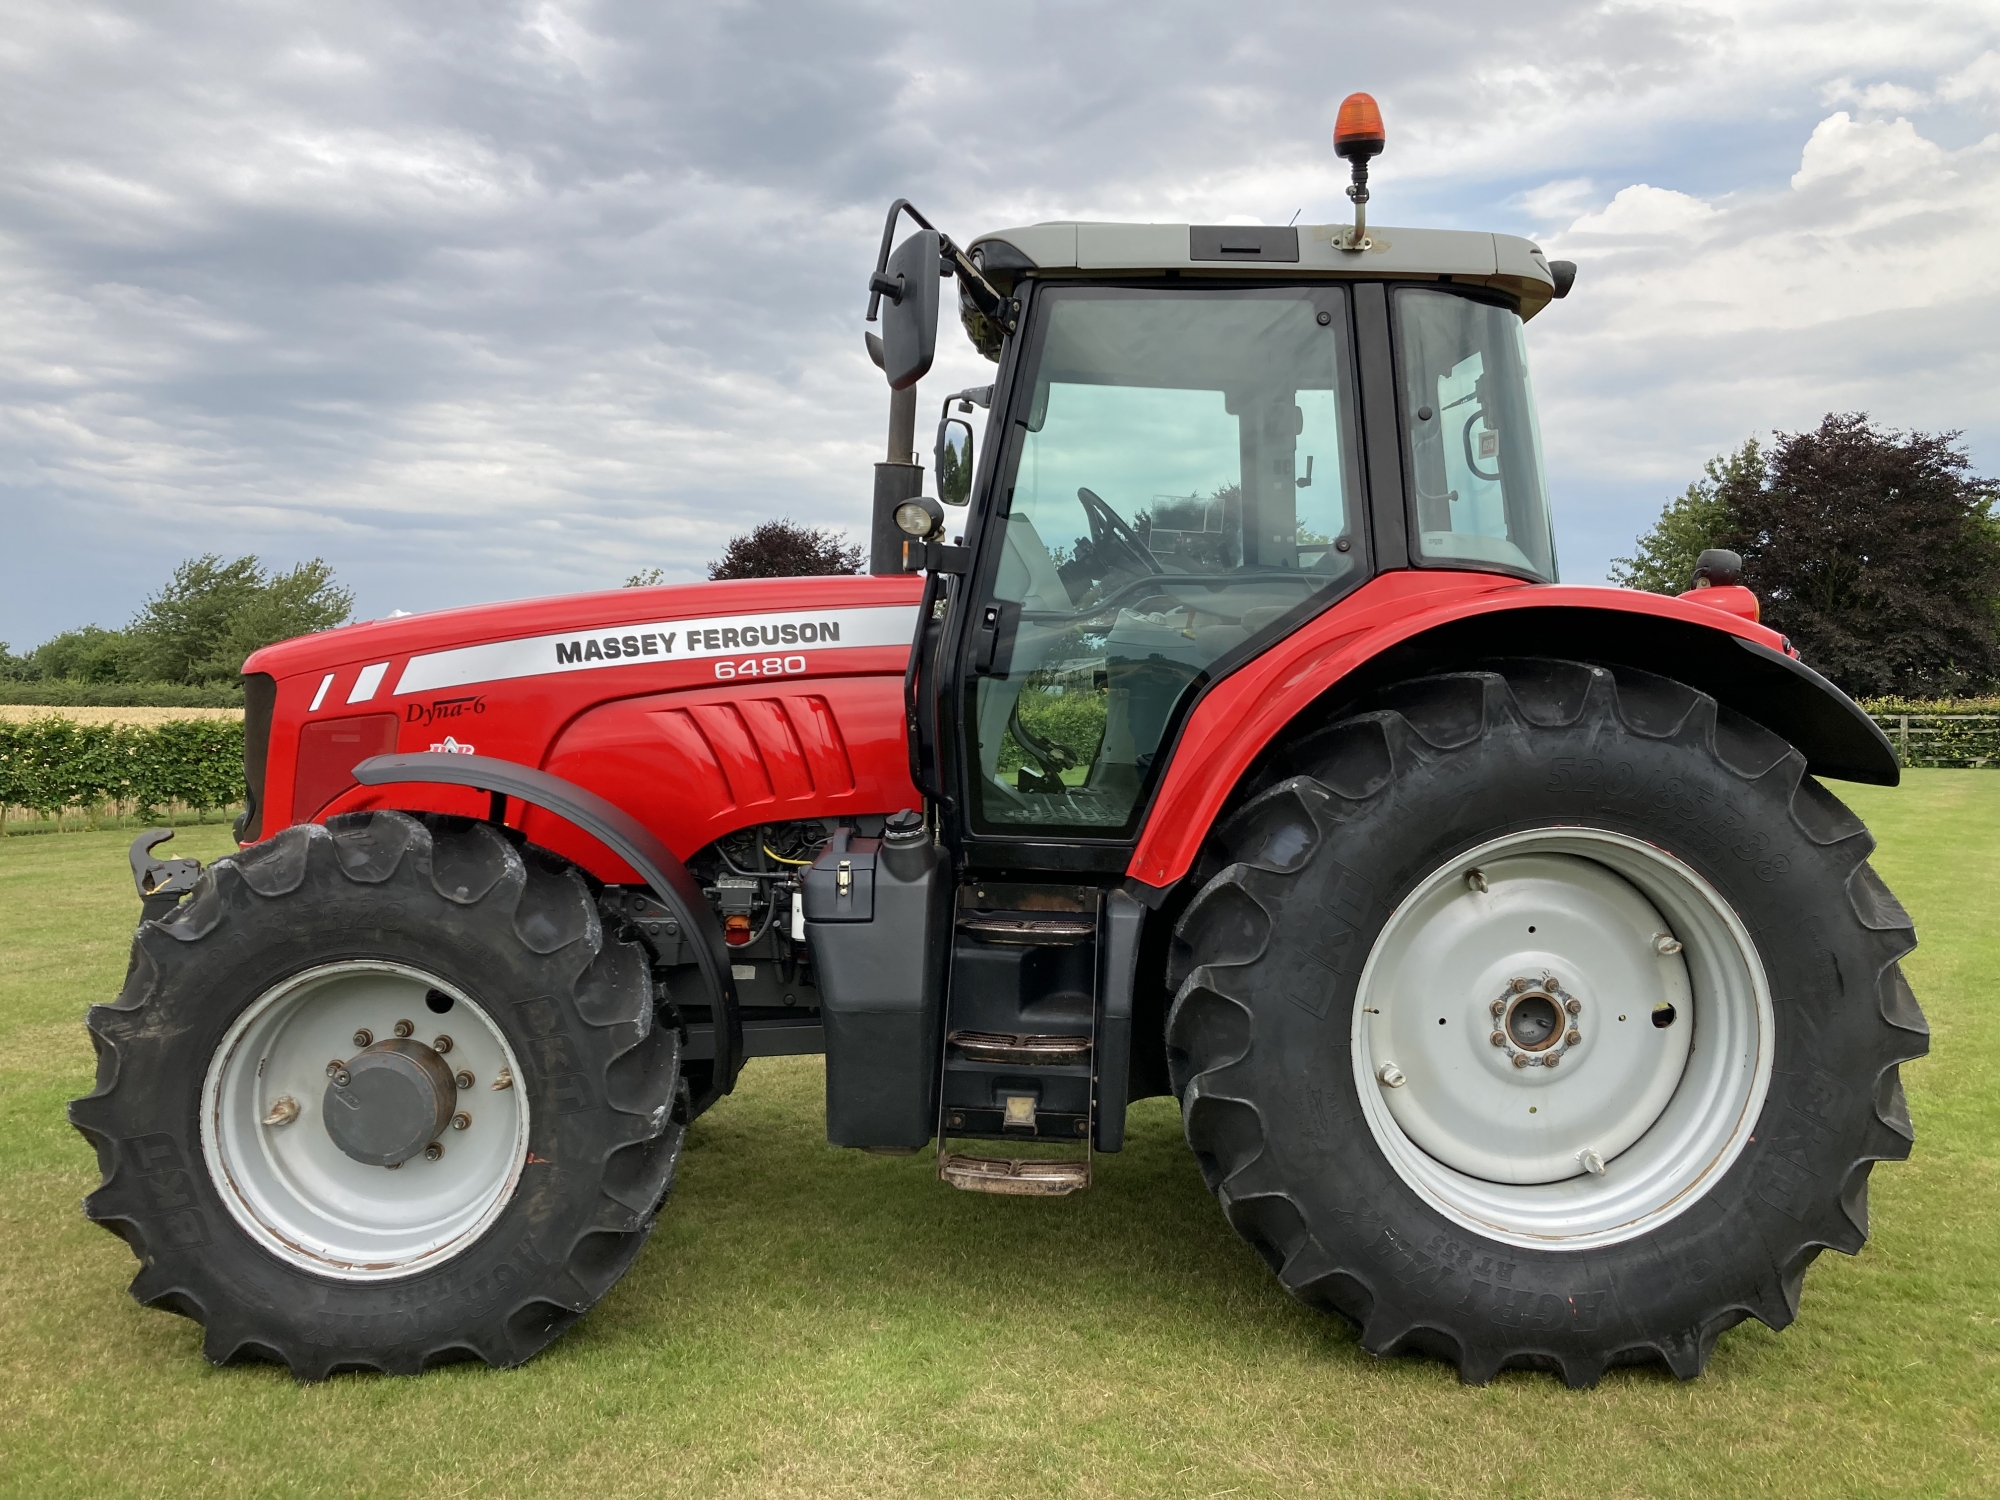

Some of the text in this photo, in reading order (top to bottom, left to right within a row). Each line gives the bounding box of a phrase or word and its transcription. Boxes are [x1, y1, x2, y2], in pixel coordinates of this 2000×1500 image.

[555, 622, 840, 664] MASSEY FERGUSON
[714, 655, 806, 680] 6480
[405, 695, 487, 727] Dyna-6
[1283, 867, 1370, 1013] BKT
[520, 998, 590, 1107] BKT
[132, 1139, 206, 1243] BKT
[1426, 1234, 1516, 1282] RT 855
